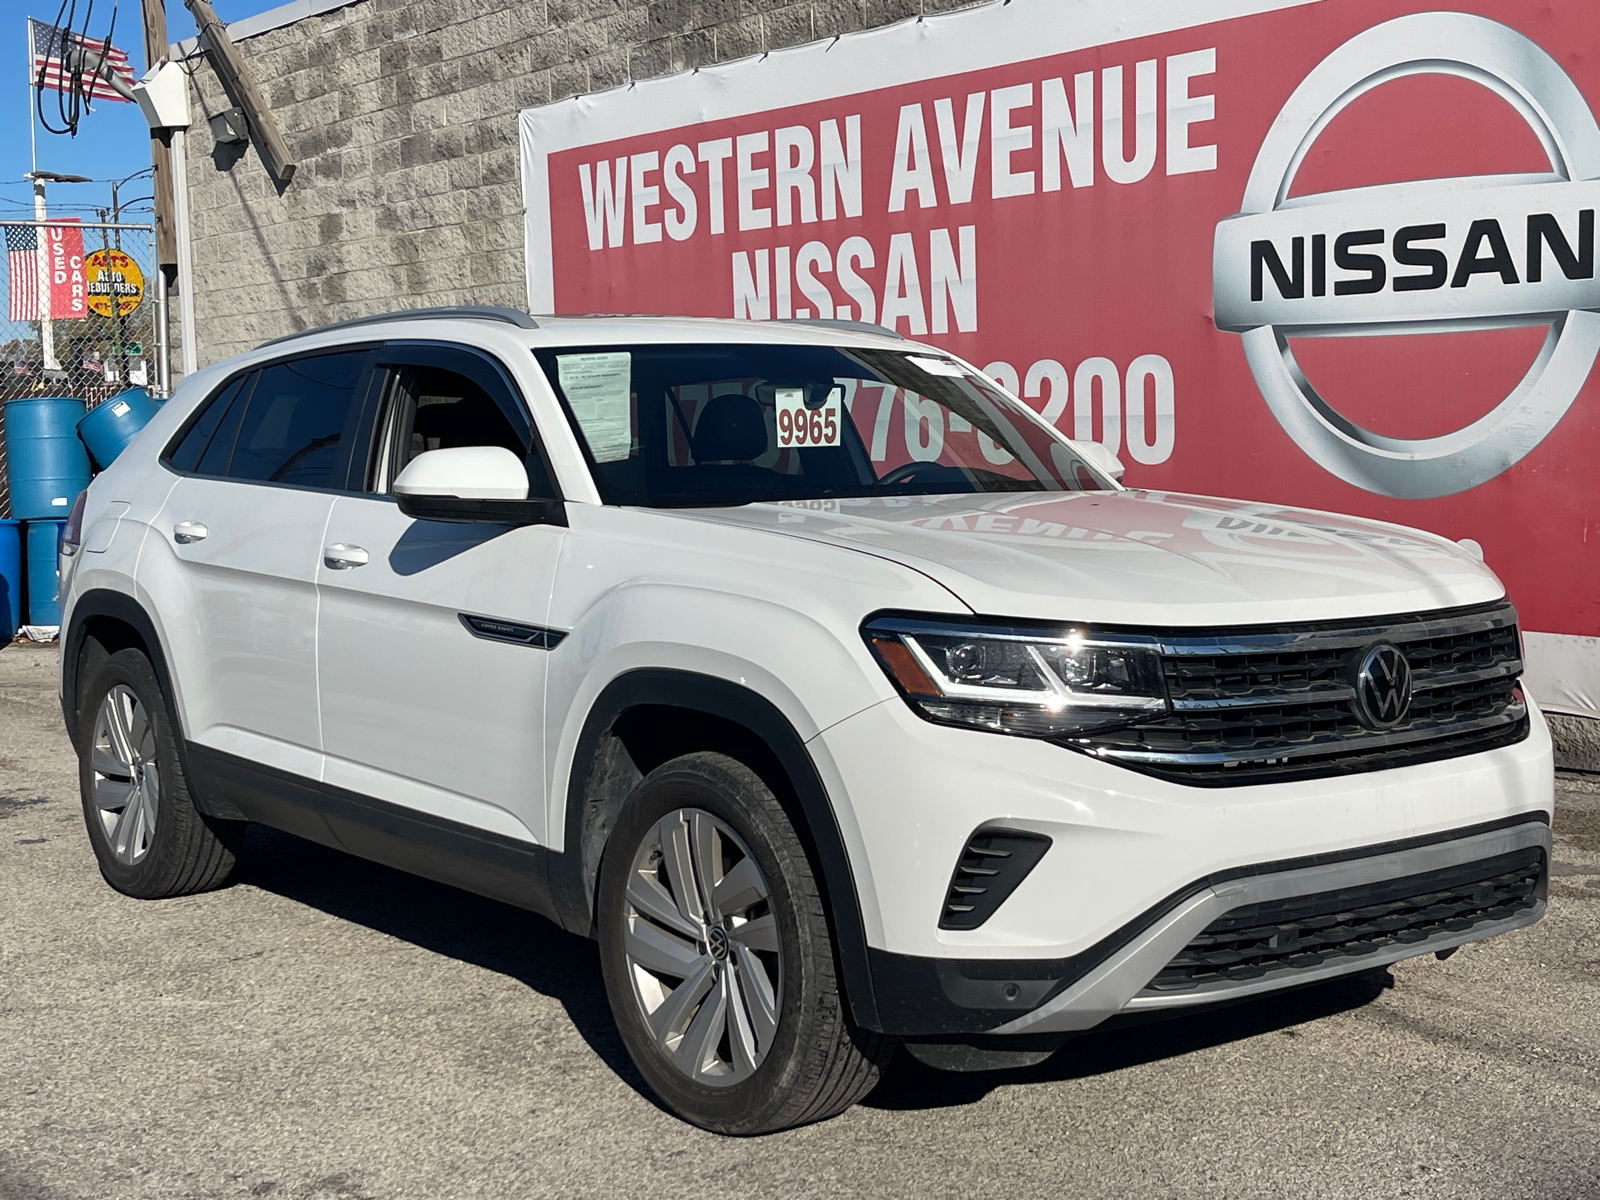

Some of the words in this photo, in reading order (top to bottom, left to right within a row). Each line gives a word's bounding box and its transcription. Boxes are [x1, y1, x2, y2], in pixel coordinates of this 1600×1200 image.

[579, 114, 862, 251] WESTERN
[888, 47, 1218, 213] AVENUE
[51, 228, 67, 285] USED
[69, 255, 83, 312] CARS
[732, 225, 978, 336] NISSAN
[1251, 209, 1595, 302] NISSAN
[779, 408, 837, 445] 9965
